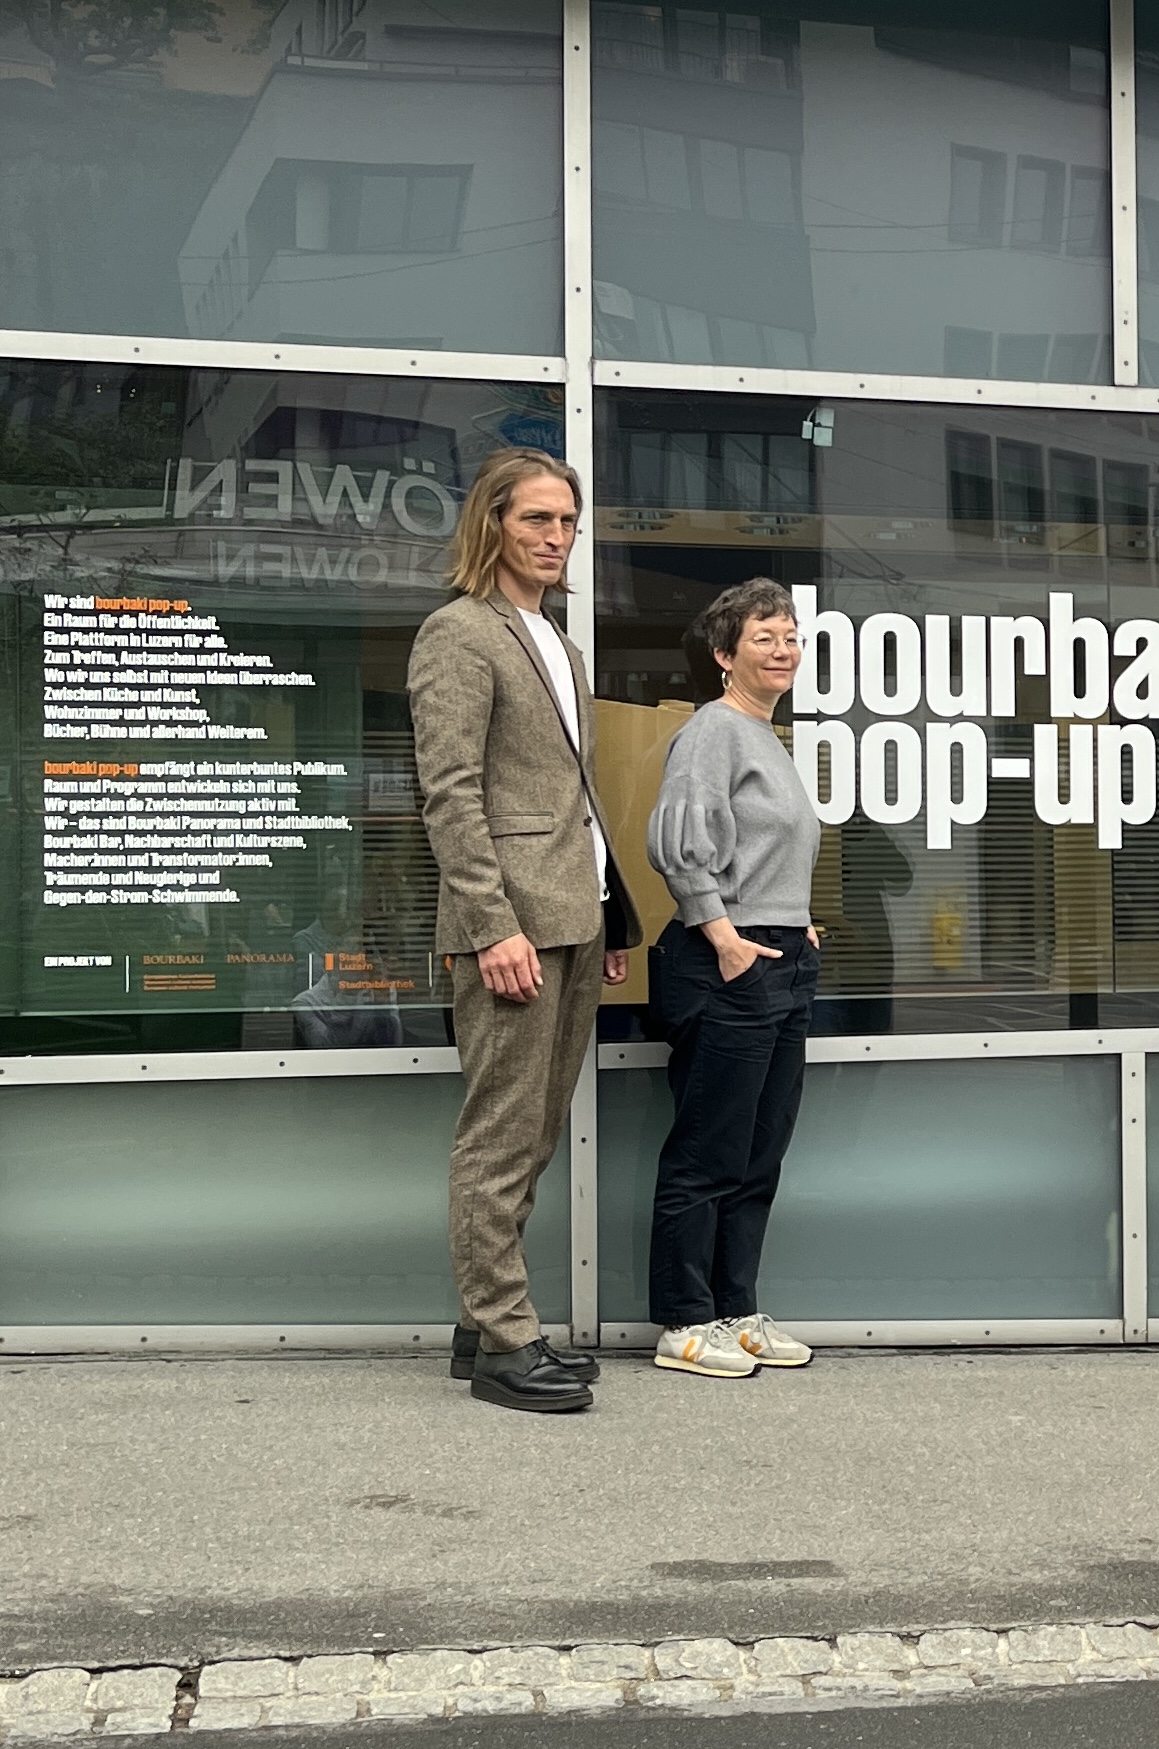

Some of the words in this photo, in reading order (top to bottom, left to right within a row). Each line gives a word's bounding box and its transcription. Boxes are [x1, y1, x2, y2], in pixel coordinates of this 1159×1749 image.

[44, 594, 68, 609] Wir
[69, 595, 94, 609] sind
[95, 596, 147, 611] bourbaki
[44, 612, 62, 627] Ein
[63, 613, 97, 627] Raum
[99, 613, 118, 628] für
[119, 614, 137, 629] die
[138, 612, 220, 630] Öffentlichkeit.
[44, 631, 69, 645] Eine
[70, 631, 129, 646] Plattform
[129, 632, 141, 647] in
[141, 633, 182, 647] Luzern
[183, 633, 203, 648] für
[204, 634, 228, 648] alle.
[44, 649, 70, 664] Zum
[71, 650, 119, 666] Treffen,
[120, 650, 196, 666] Austauschen
[197, 652, 218, 666] und
[219, 652, 273, 667] Kreieren.
[44, 668, 65, 683] Wo
[66, 669, 88, 683] wir
[89, 671, 111, 683] uns
[112, 669, 149, 684] selbst
[149, 670, 170, 684] mit
[170, 672, 206, 685] neuen
[206, 671, 238, 685] Ideen
[44, 686, 102, 701] Zwischen
[102, 687, 139, 702] Küche
[140, 688, 162, 702] und
[163, 688, 200, 704] Kunst,
[44, 705, 123, 720] Wohnzimmer
[123, 706, 146, 720] und
[147, 706, 210, 723] Workshop,
[44, 723, 90, 740] Bücher,
[90, 724, 128, 738] Bühne
[129, 724, 151, 738] und
[152, 724, 206, 739] allerhand
[44, 760, 97, 775] bourbaki
[98, 763, 138, 777] pop-up
[139, 761, 195, 777] empfängt
[196, 761, 214, 775] ein
[215, 761, 292, 776] kunterbuntes
[293, 761, 347, 776] Publikum.
[43, 779, 78, 793] Raum
[79, 779, 101, 793] und
[102, 779, 166, 796] Programm
[167, 779, 230, 793] entwickeln
[232, 779, 256, 793] sich
[256, 780, 276, 793] mit
[277, 781, 301, 793] uns.
[792, 720, 1157, 850] pop-up
[44, 797, 68, 812] Wir
[69, 798, 125, 814] gestalten
[126, 798, 143, 812] die
[144, 798, 246, 814] Zwischennutzung
[247, 798, 277, 811] aktiv
[277, 798, 300, 811] mit.
[44, 816, 68, 830] Wir
[78, 816, 101, 830] das
[102, 816, 127, 830] sind
[128, 816, 181, 830] Bourbaki
[181, 816, 241, 830] Panorama
[242, 816, 263, 830] und
[264, 816, 352, 831] Stadtbibliothek,
[43, 834, 98, 849] Bourbaki
[99, 834, 124, 850] Bar,
[124, 834, 213, 848] Nachbarschaft
[213, 834, 234, 848] und
[235, 833, 307, 849] Kulturszene,
[127, 853, 149, 867] und
[44, 871, 110, 885] Träumende
[111, 871, 133, 885] und
[134, 871, 197, 887] Neugierige
[198, 870, 220, 884] und
[43, 888, 240, 906] Gegen-den-Strom-Schwimmende.
[143, 955, 204, 965] BOURBAKI
[226, 953, 294, 964] PANORAMA
